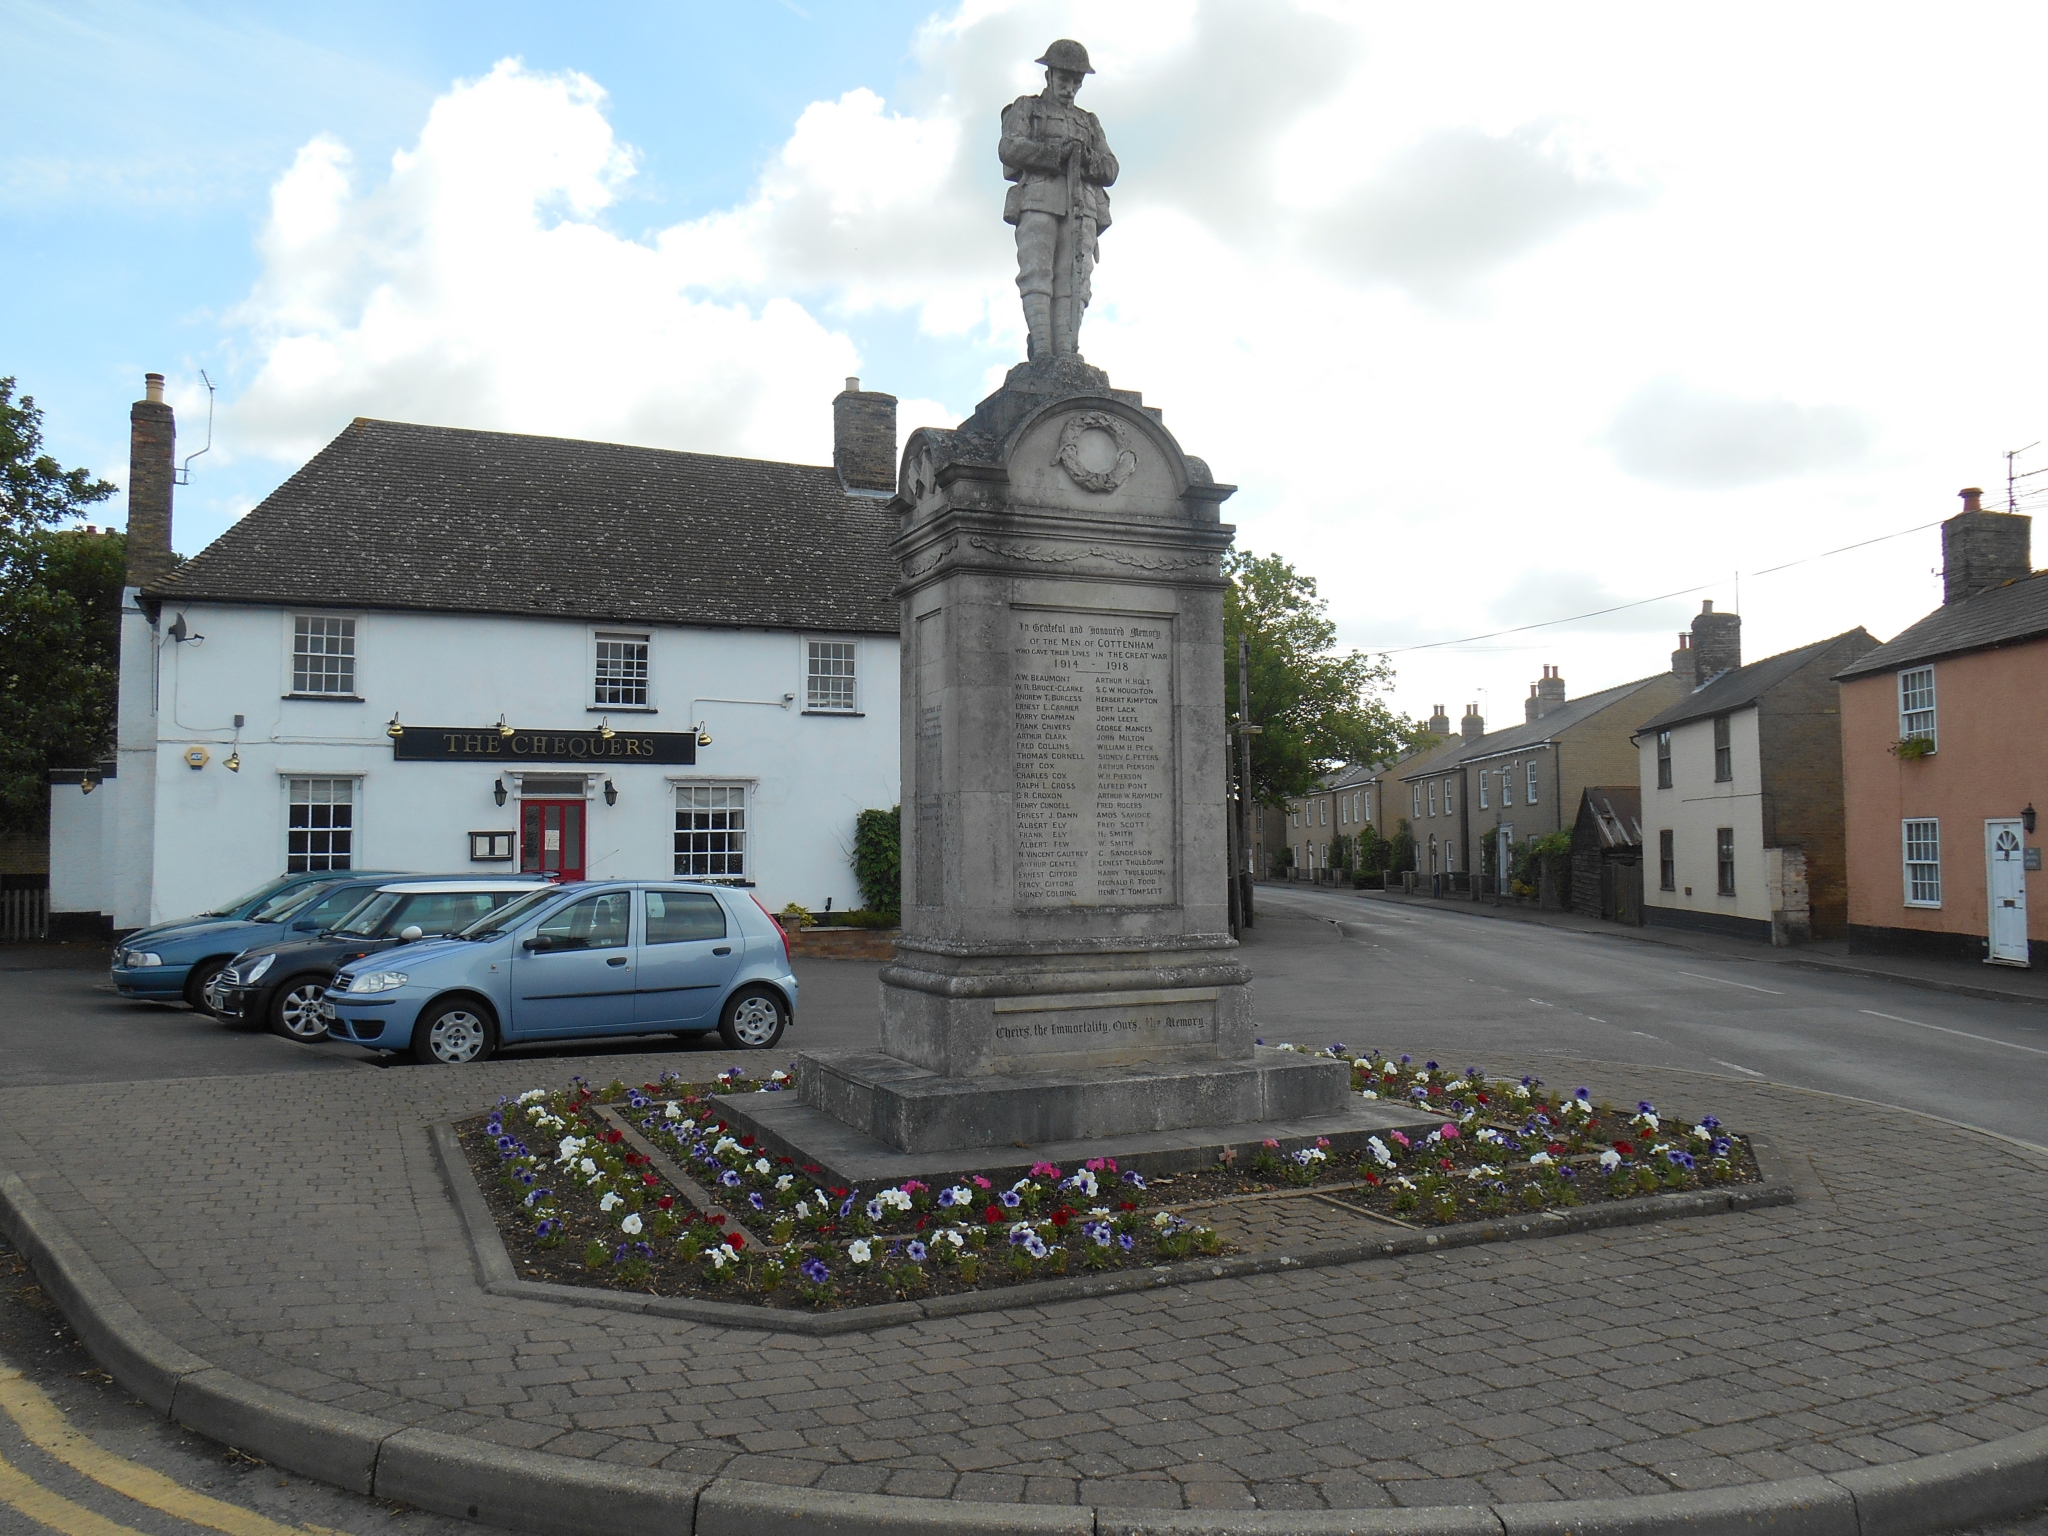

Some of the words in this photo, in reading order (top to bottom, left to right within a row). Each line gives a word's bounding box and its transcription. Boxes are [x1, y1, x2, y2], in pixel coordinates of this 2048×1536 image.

[1070, 624, 1082, 634] and
[1130, 628, 1160, 640] Memory
[1042, 638, 1058, 646] THE
[1062, 638, 1080, 646] MEN
[1098, 638, 1154, 650] COTTENHAM
[1072, 650, 1090, 658] LIVES
[1125, 652, 1149, 660] GREAT
[1054, 659, 1079, 668] 1914
[1107, 662, 1128, 671] 1918
[444, 734, 500, 753] THE
[511, 735, 654, 758] CHEQUERS
[1034, 1024, 1047, 1036] the
